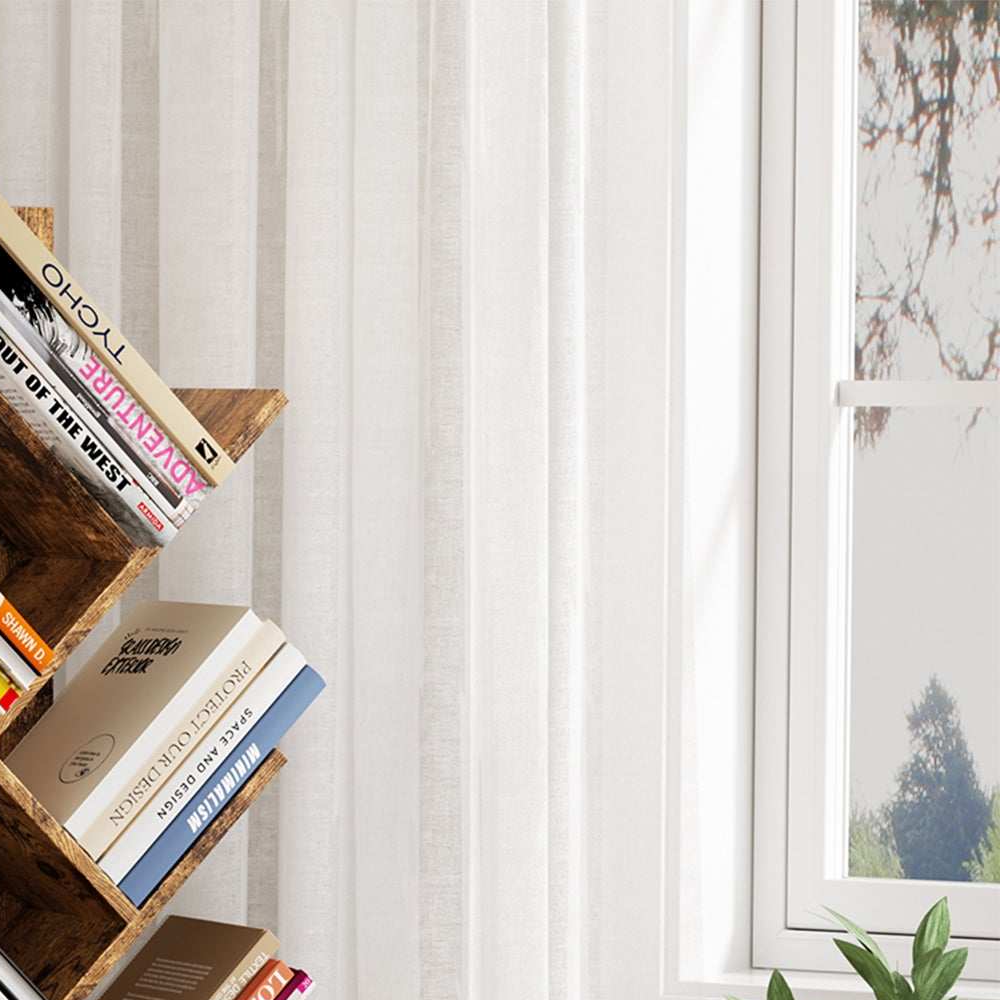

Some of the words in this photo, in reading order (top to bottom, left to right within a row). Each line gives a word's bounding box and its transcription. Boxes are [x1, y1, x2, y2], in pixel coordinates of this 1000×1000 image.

[37, 259, 132, 365] TYCHO
[22, 372, 52, 403] OF
[44, 397, 84, 440] THE
[77, 434, 132, 494] WEST
[76, 356, 205, 500] ADVENTURE
[0, 610, 38, 652] SHAWN
[32, 647, 49, 665] D.
[185, 658, 253, 735] PROTECT
[156, 728, 194, 769] OUR
[217, 706, 254, 747] SPACE
[182, 741, 264, 834] MINIMALISM
[194, 745, 221, 774] AND
[106, 765, 162, 827] DESIGN
[155, 773, 197, 820] DESIGN
[236, 949, 270, 986] TEXTILE
